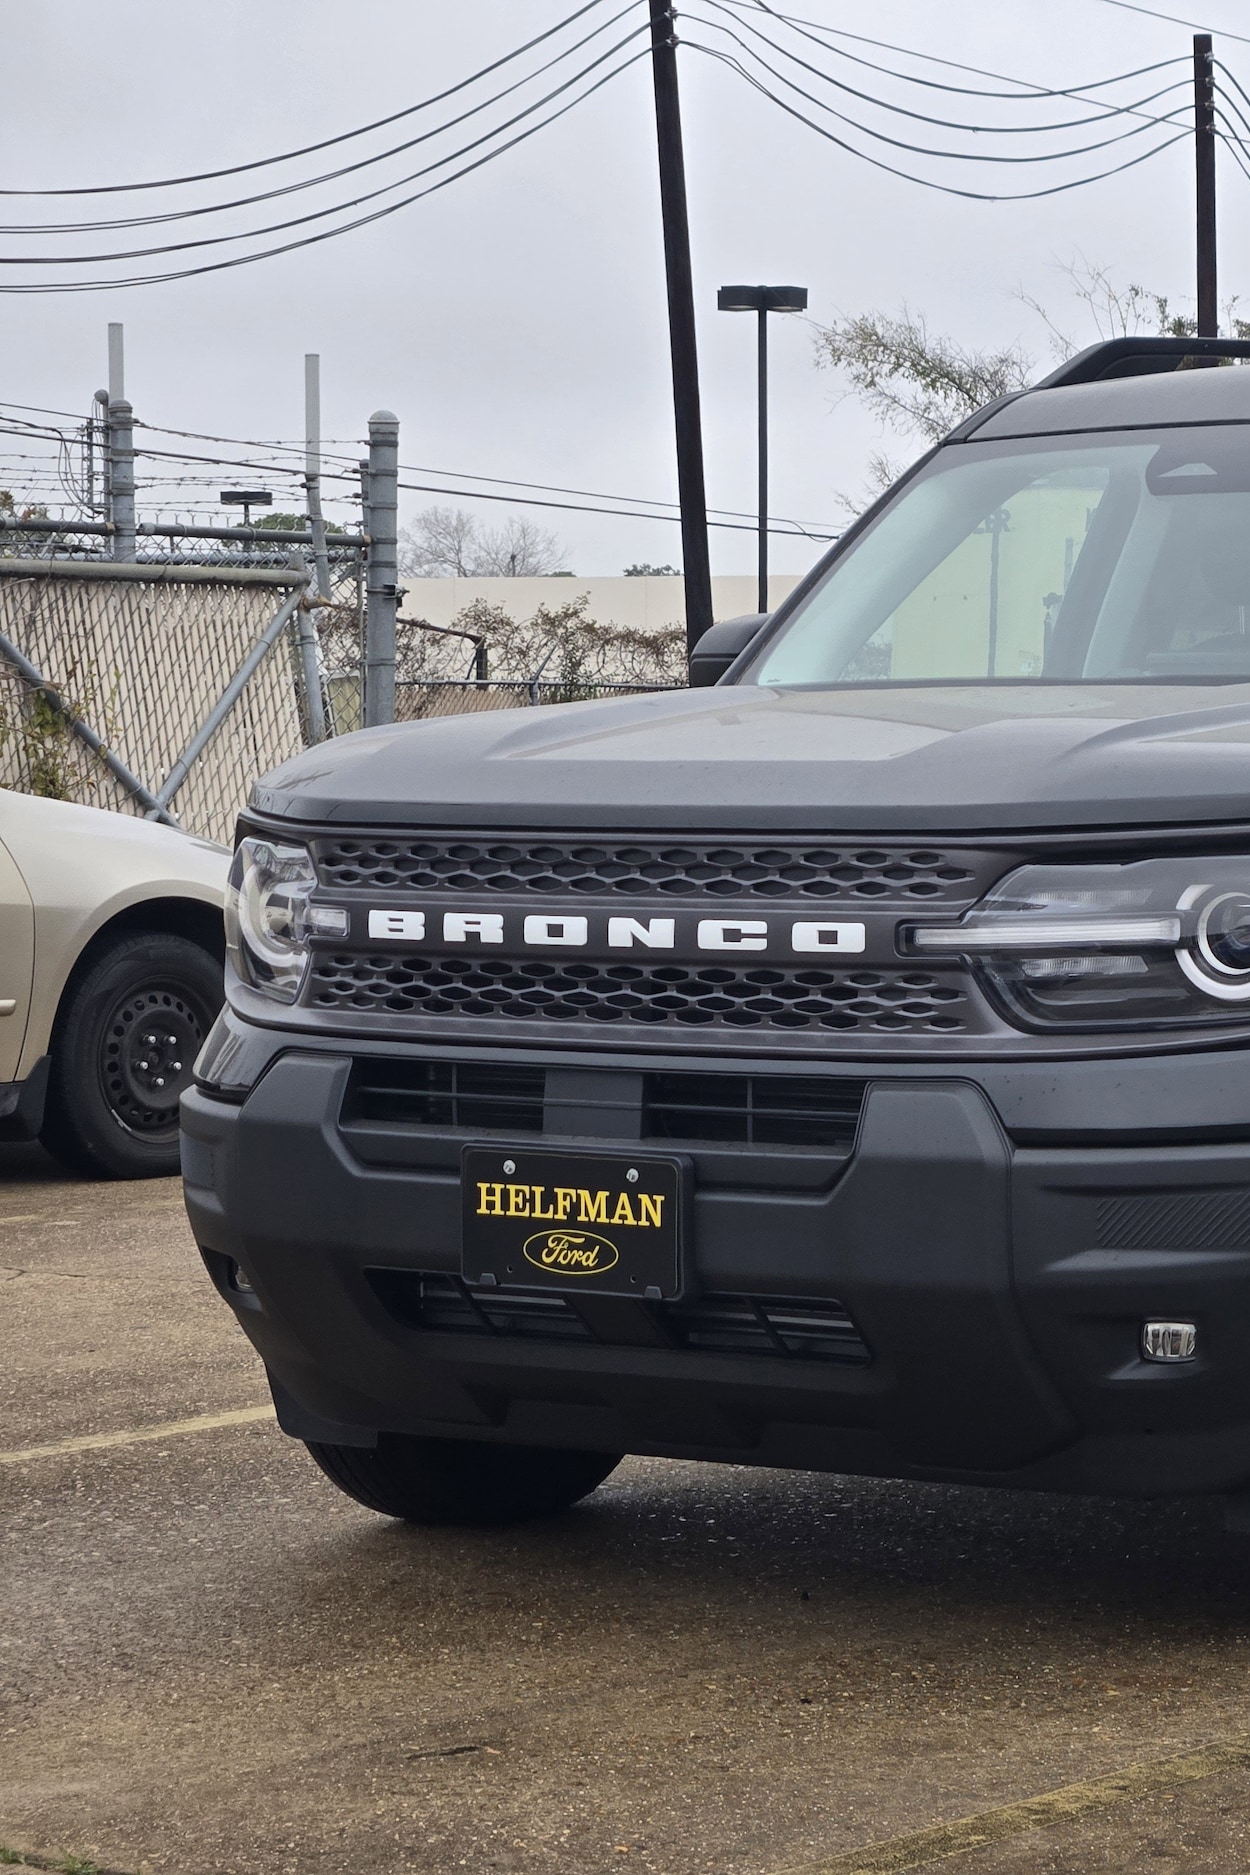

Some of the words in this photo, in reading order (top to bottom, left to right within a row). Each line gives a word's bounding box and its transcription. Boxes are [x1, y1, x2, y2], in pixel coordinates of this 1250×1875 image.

[367, 909, 866, 954] BRONCO
[476, 1182, 665, 1228] HELFMAN
[541, 1234, 600, 1268] Ford
